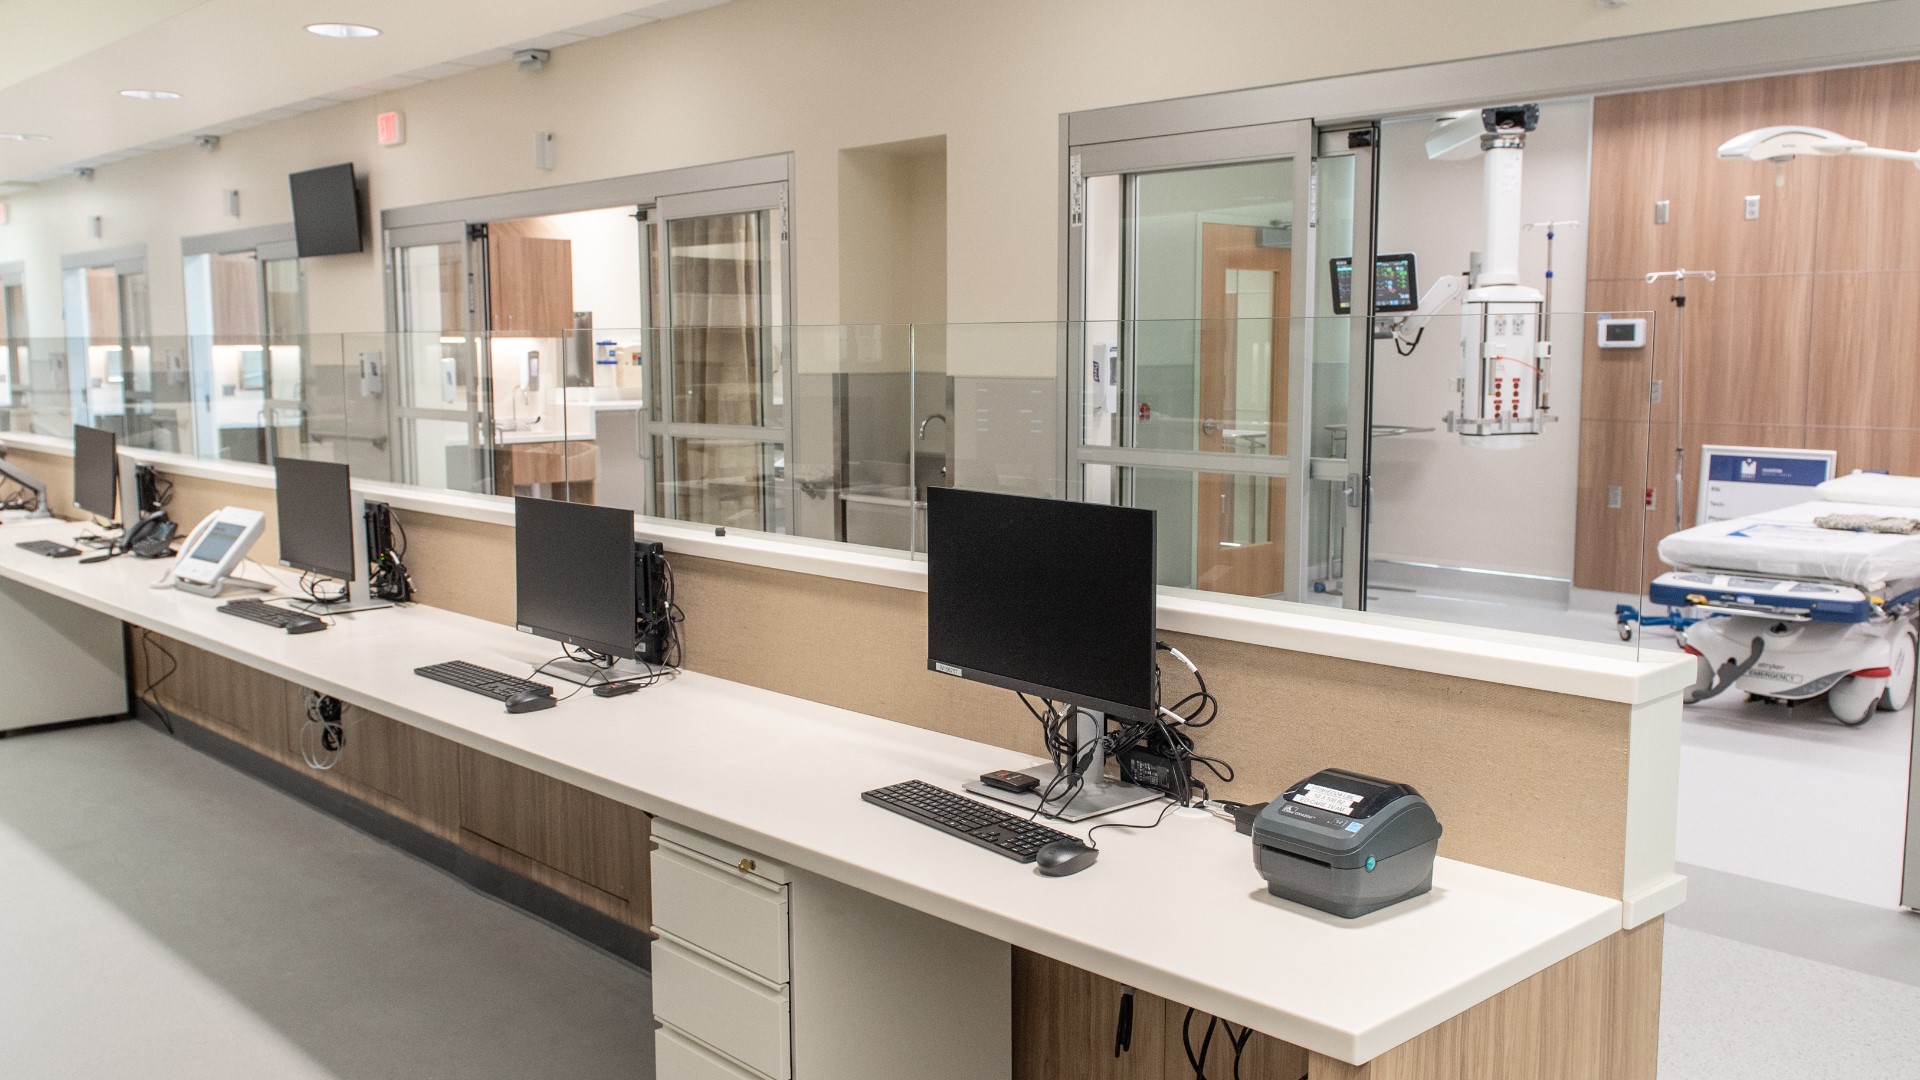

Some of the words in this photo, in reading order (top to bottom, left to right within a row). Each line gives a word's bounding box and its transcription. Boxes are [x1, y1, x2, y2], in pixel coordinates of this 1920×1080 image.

[1757, 662, 1785, 670] stryker
[1748, 670, 1795, 682] EMERGENCY
[1309, 799, 1326, 807] CARE
[1327, 804, 1345, 812] TEAM
